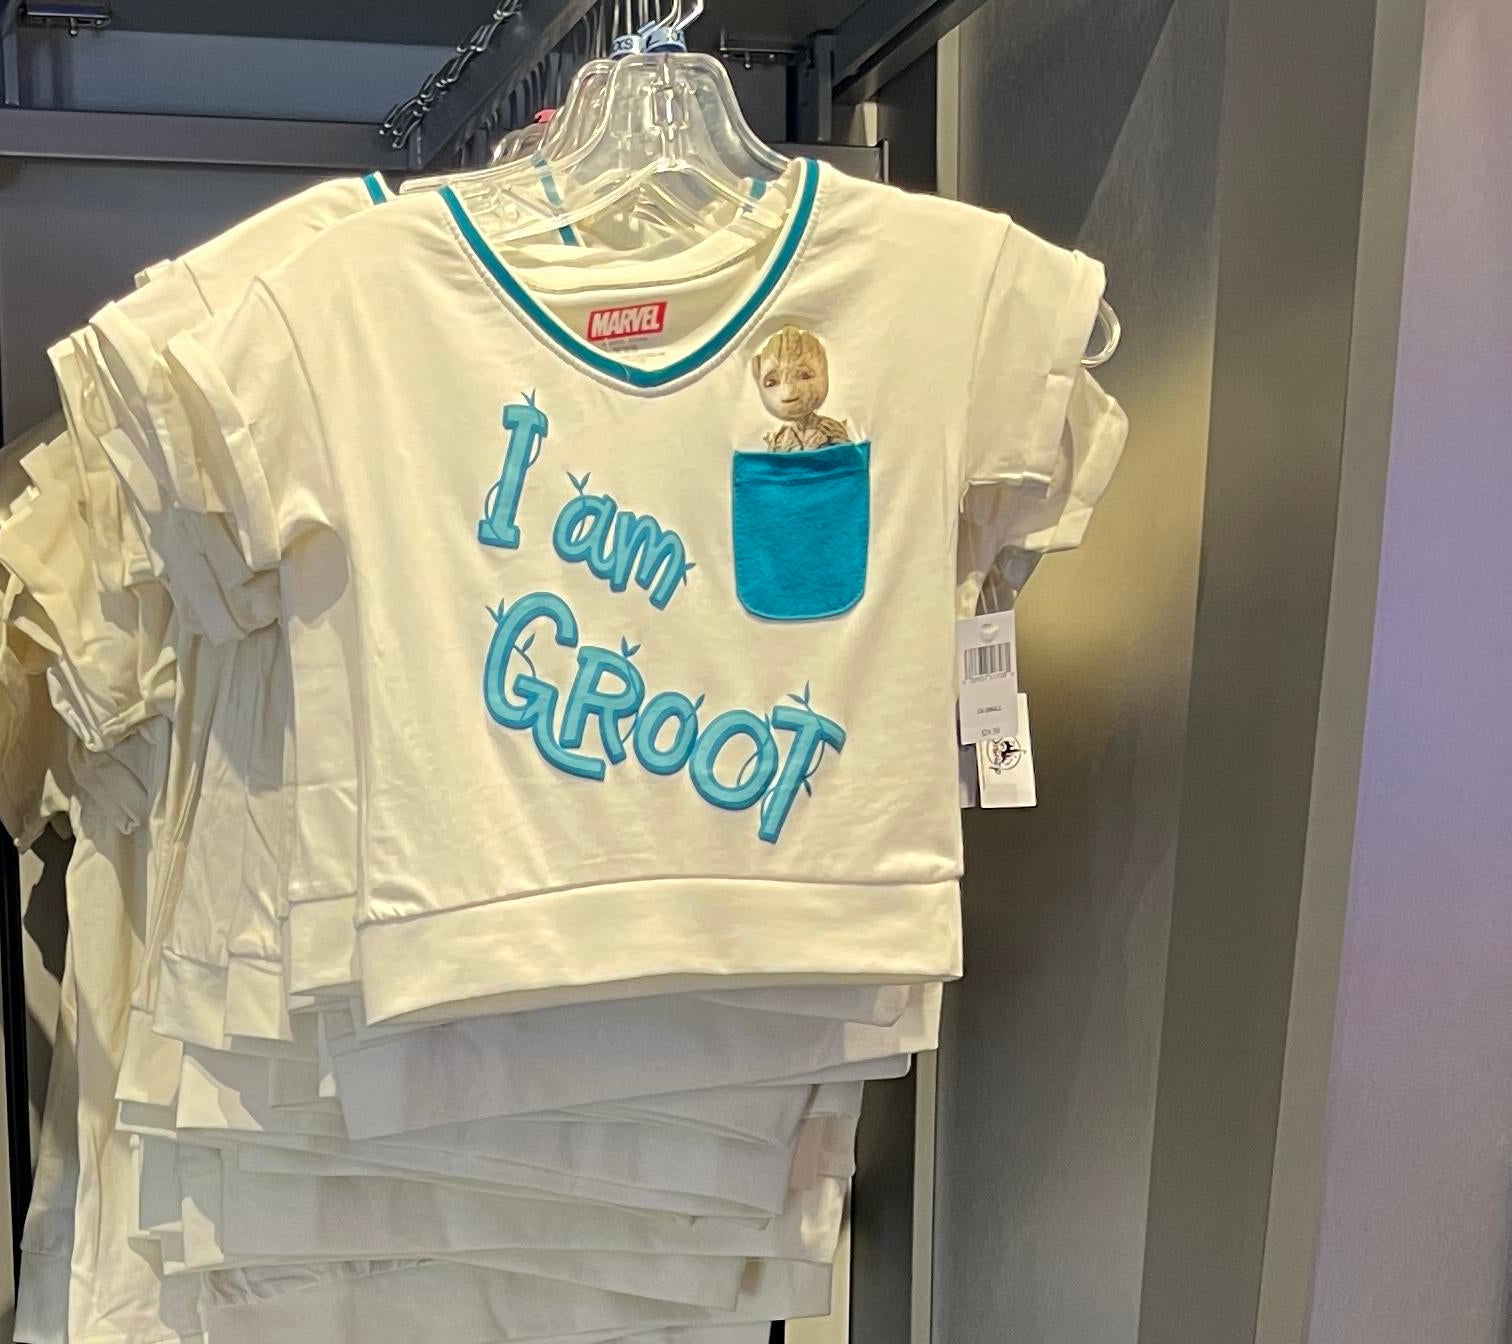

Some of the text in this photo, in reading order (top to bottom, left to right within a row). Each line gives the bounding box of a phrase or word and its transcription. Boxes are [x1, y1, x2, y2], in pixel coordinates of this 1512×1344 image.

[590, 304, 661, 339] MARVEL
[478, 400, 689, 611] I am
[483, 592, 846, 844] GROOT
